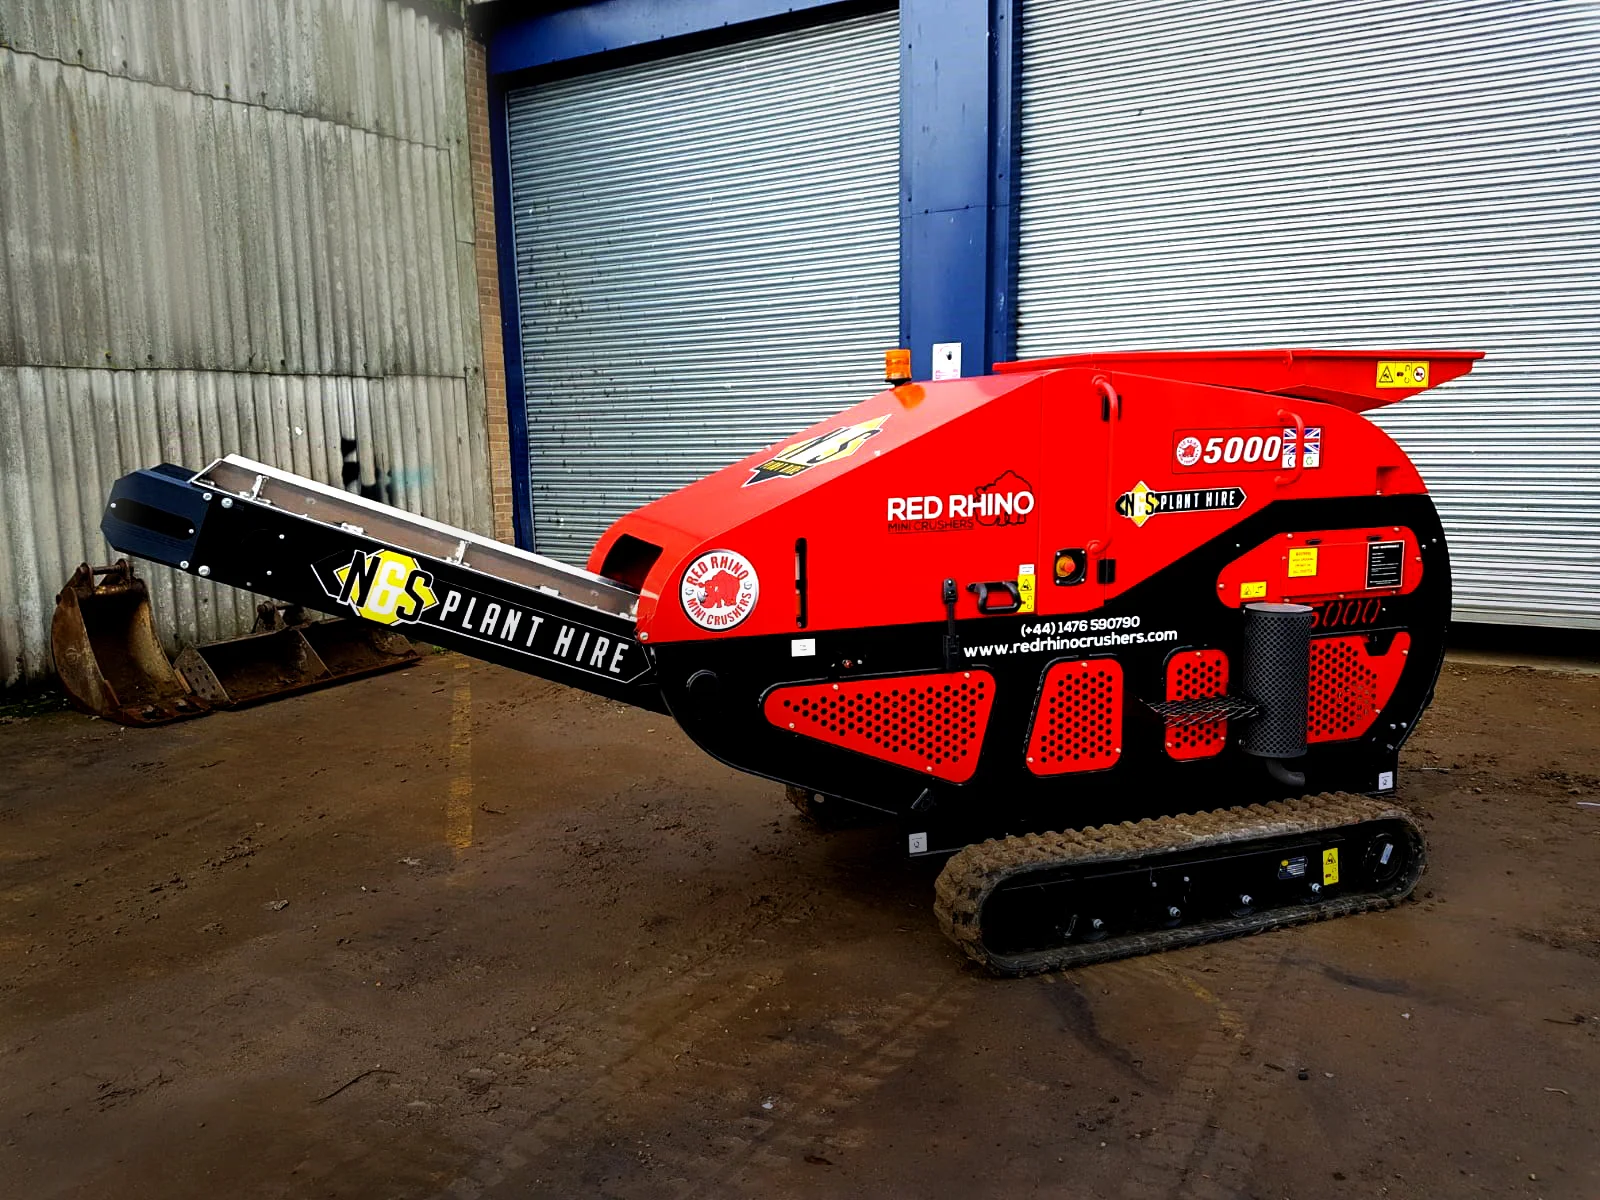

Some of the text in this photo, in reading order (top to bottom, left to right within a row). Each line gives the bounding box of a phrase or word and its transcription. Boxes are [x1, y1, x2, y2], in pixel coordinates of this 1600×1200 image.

[1203, 436, 1282, 463] 5000
[887, 490, 1035, 521] RED RHINO
[1160, 493, 1200, 510] PLANT
[1205, 491, 1236, 508] HIRE
[887, 518, 974, 532] MINI CRUSHERS
[686, 556, 749, 586] RED RHINO
[686, 592, 752, 625] MINI CRUSHERS
[439, 590, 544, 647] PLANT
[553, 625, 629, 673] HIRE
[1020, 616, 1140, 638] (+44) 1476 590790
[963, 629, 1178, 658] www.redrhinocrushers.com
